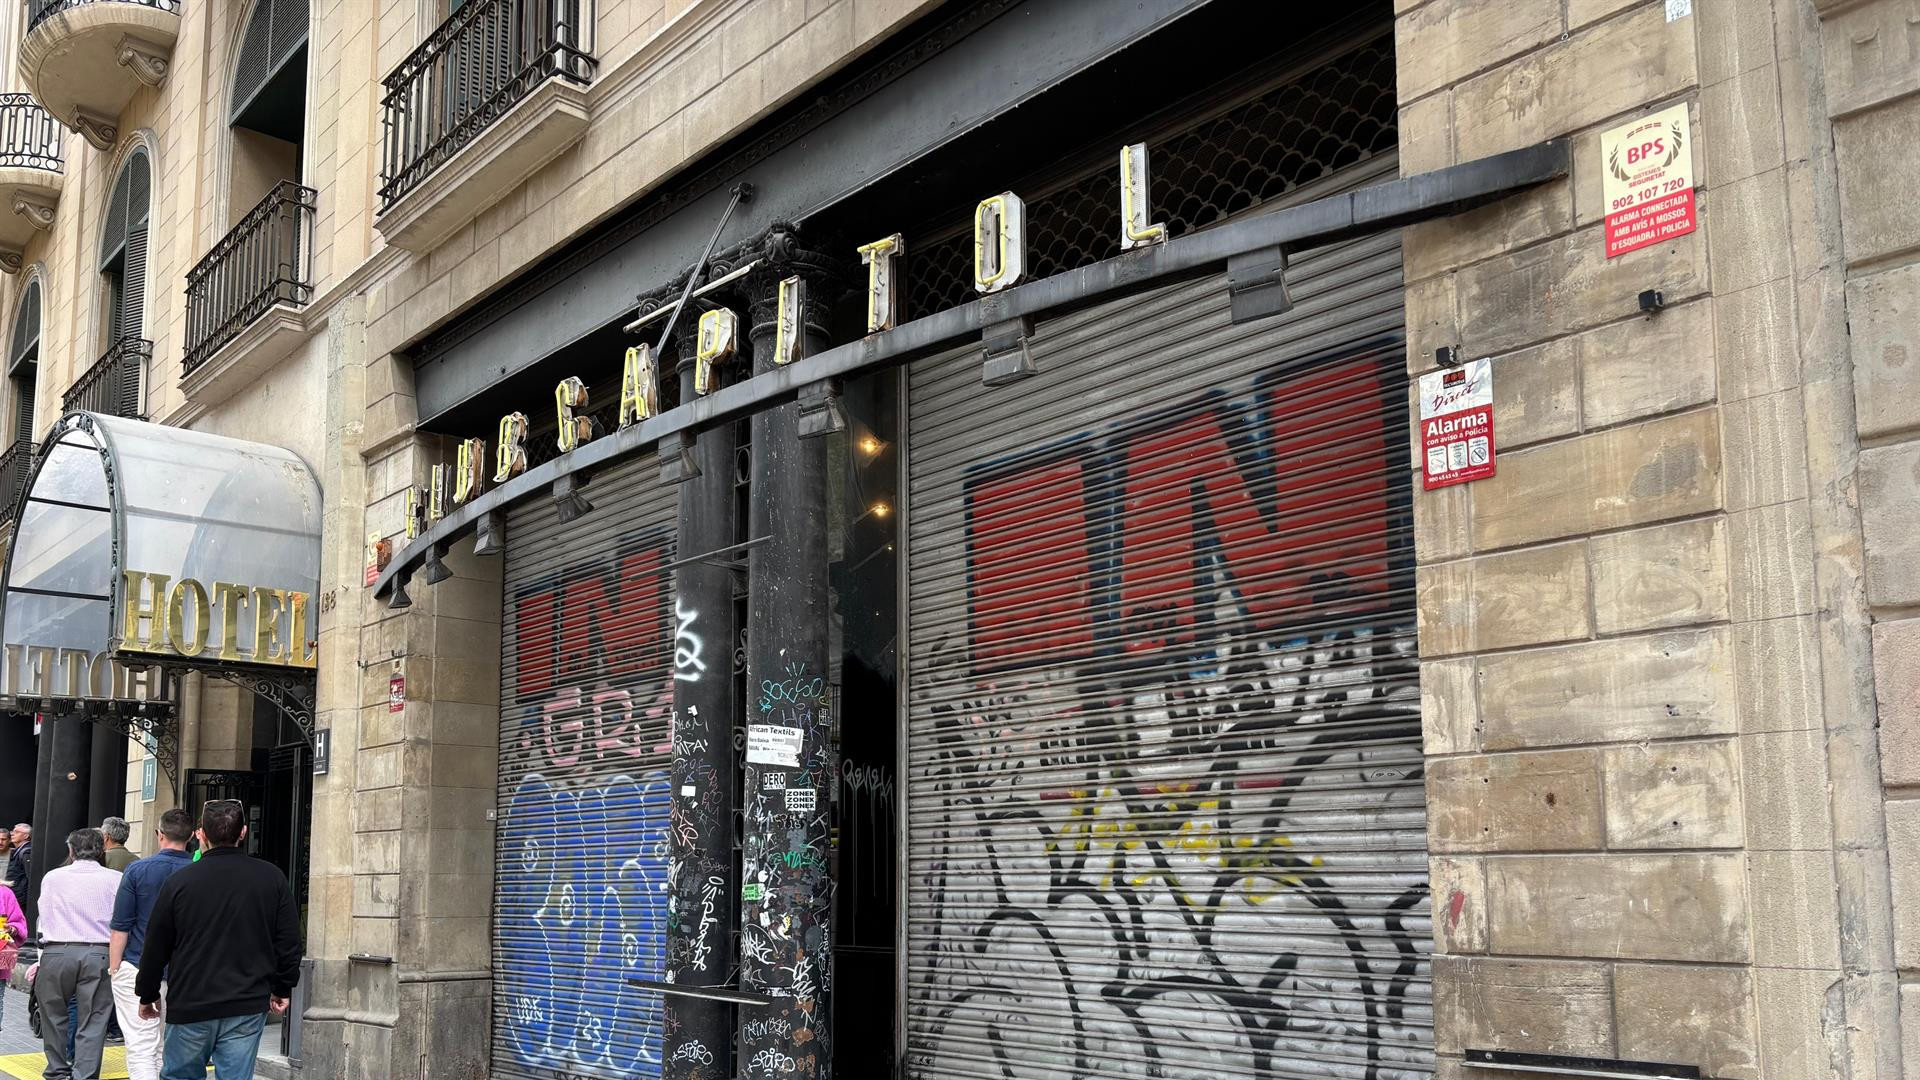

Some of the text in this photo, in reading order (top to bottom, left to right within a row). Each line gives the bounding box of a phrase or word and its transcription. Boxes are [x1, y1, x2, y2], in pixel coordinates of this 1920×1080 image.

[1627, 137, 1665, 165] BPS
[1612, 177, 1685, 210] 902 107 720
[1611, 195, 1689, 227] ALARMA CONNECTADA
[1614, 225, 1631, 238] AMB
[1650, 218, 1656, 228] A
[1656, 208, 1686, 224] MOSSOS
[1611, 231, 1656, 251] D'ESQUADRA
[1661, 219, 1691, 236] POLICIA
[1432, 380, 1480, 411] Direct
[1426, 411, 1488, 437] Alarma
[1426, 436, 1439, 446] con
[1440, 433, 1458, 444] aviso
[117, 569, 318, 666] HOTEL
[316, 733, 324, 758] H
[145, 764, 152, 786] H
[763, 773, 785, 785] DERO
